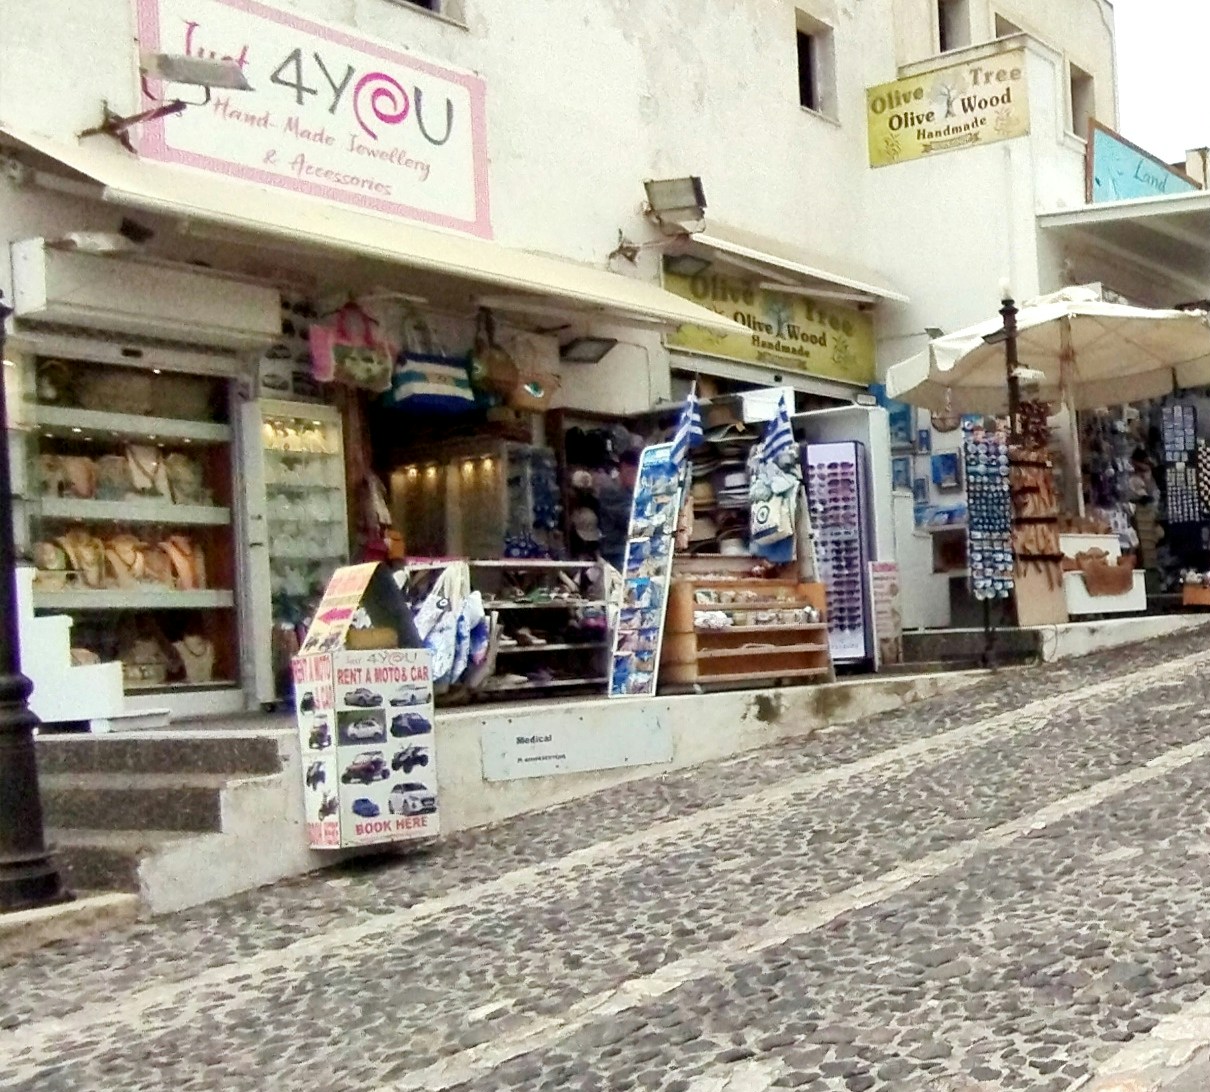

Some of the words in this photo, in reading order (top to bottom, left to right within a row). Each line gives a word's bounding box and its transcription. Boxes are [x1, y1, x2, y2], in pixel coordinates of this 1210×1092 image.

[181, 18, 249, 70] Jt
[871, 87, 924, 115] Olive
[969, 66, 1022, 87] Tree
[888, 110, 935, 131] Olive
[961, 87, 1012, 114] Wood
[916, 115, 987, 141] Handmade
[284, 117, 336, 146] Made
[350, 134, 431, 181] Jewellery
[289, 152, 393, 196] Accessories
[1133, 159, 1168, 193] Land
[733, 311, 773, 334] Olive
[787, 324, 827, 347] Wood
[752, 335, 811, 358] Handmade
[337, 667, 362, 685] RENT
[365, 668, 372, 684] A
[410, 666, 429, 681] CAR
[516, 734, 552, 744] Medical
[355, 820, 392, 836] BOOK
[396, 816, 428, 831] HERE
